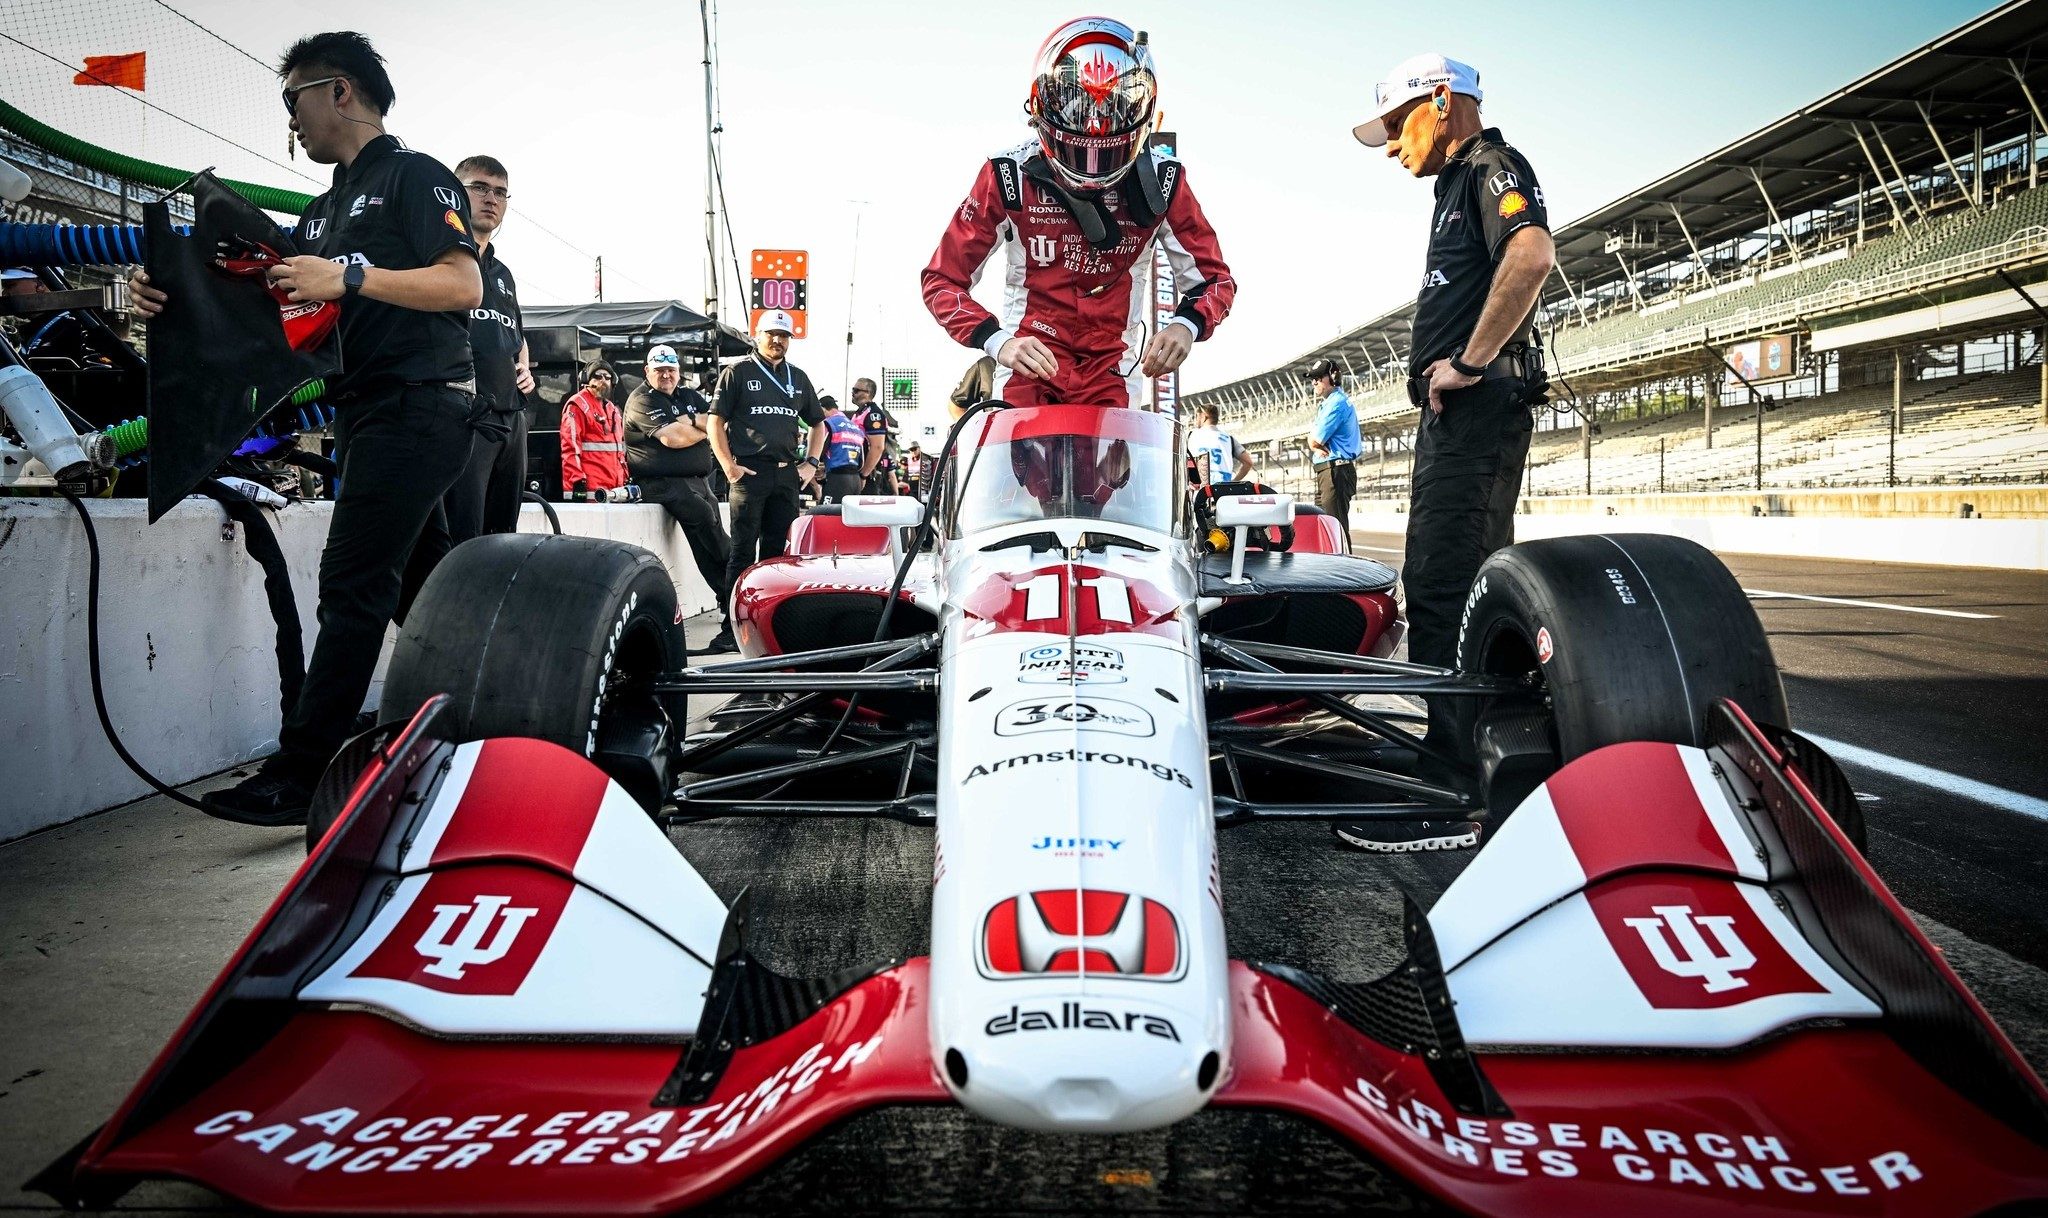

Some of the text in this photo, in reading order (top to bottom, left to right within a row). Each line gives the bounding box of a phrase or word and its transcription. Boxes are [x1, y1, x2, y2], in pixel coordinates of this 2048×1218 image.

[999, 162, 1017, 202] sparco
[1160, 165, 1177, 201] parco
[282, 302, 318, 321] sparco
[762, 279, 796, 309] 06
[924, 426, 935, 436] 21
[1015, 573, 1134, 625] 11
[1456, 576, 1488, 669] irestone
[961, 748, 1194, 789] Armstrong's
[984, 1002, 1182, 1044] dallara
[193, 1034, 882, 1174] CANCER RESEARCH
[299, 1043, 826, 1143] ACCELERATING
[1355, 1076, 1924, 1195] CURES CANCER
[1411, 1098, 1791, 1162] RESEARCH
